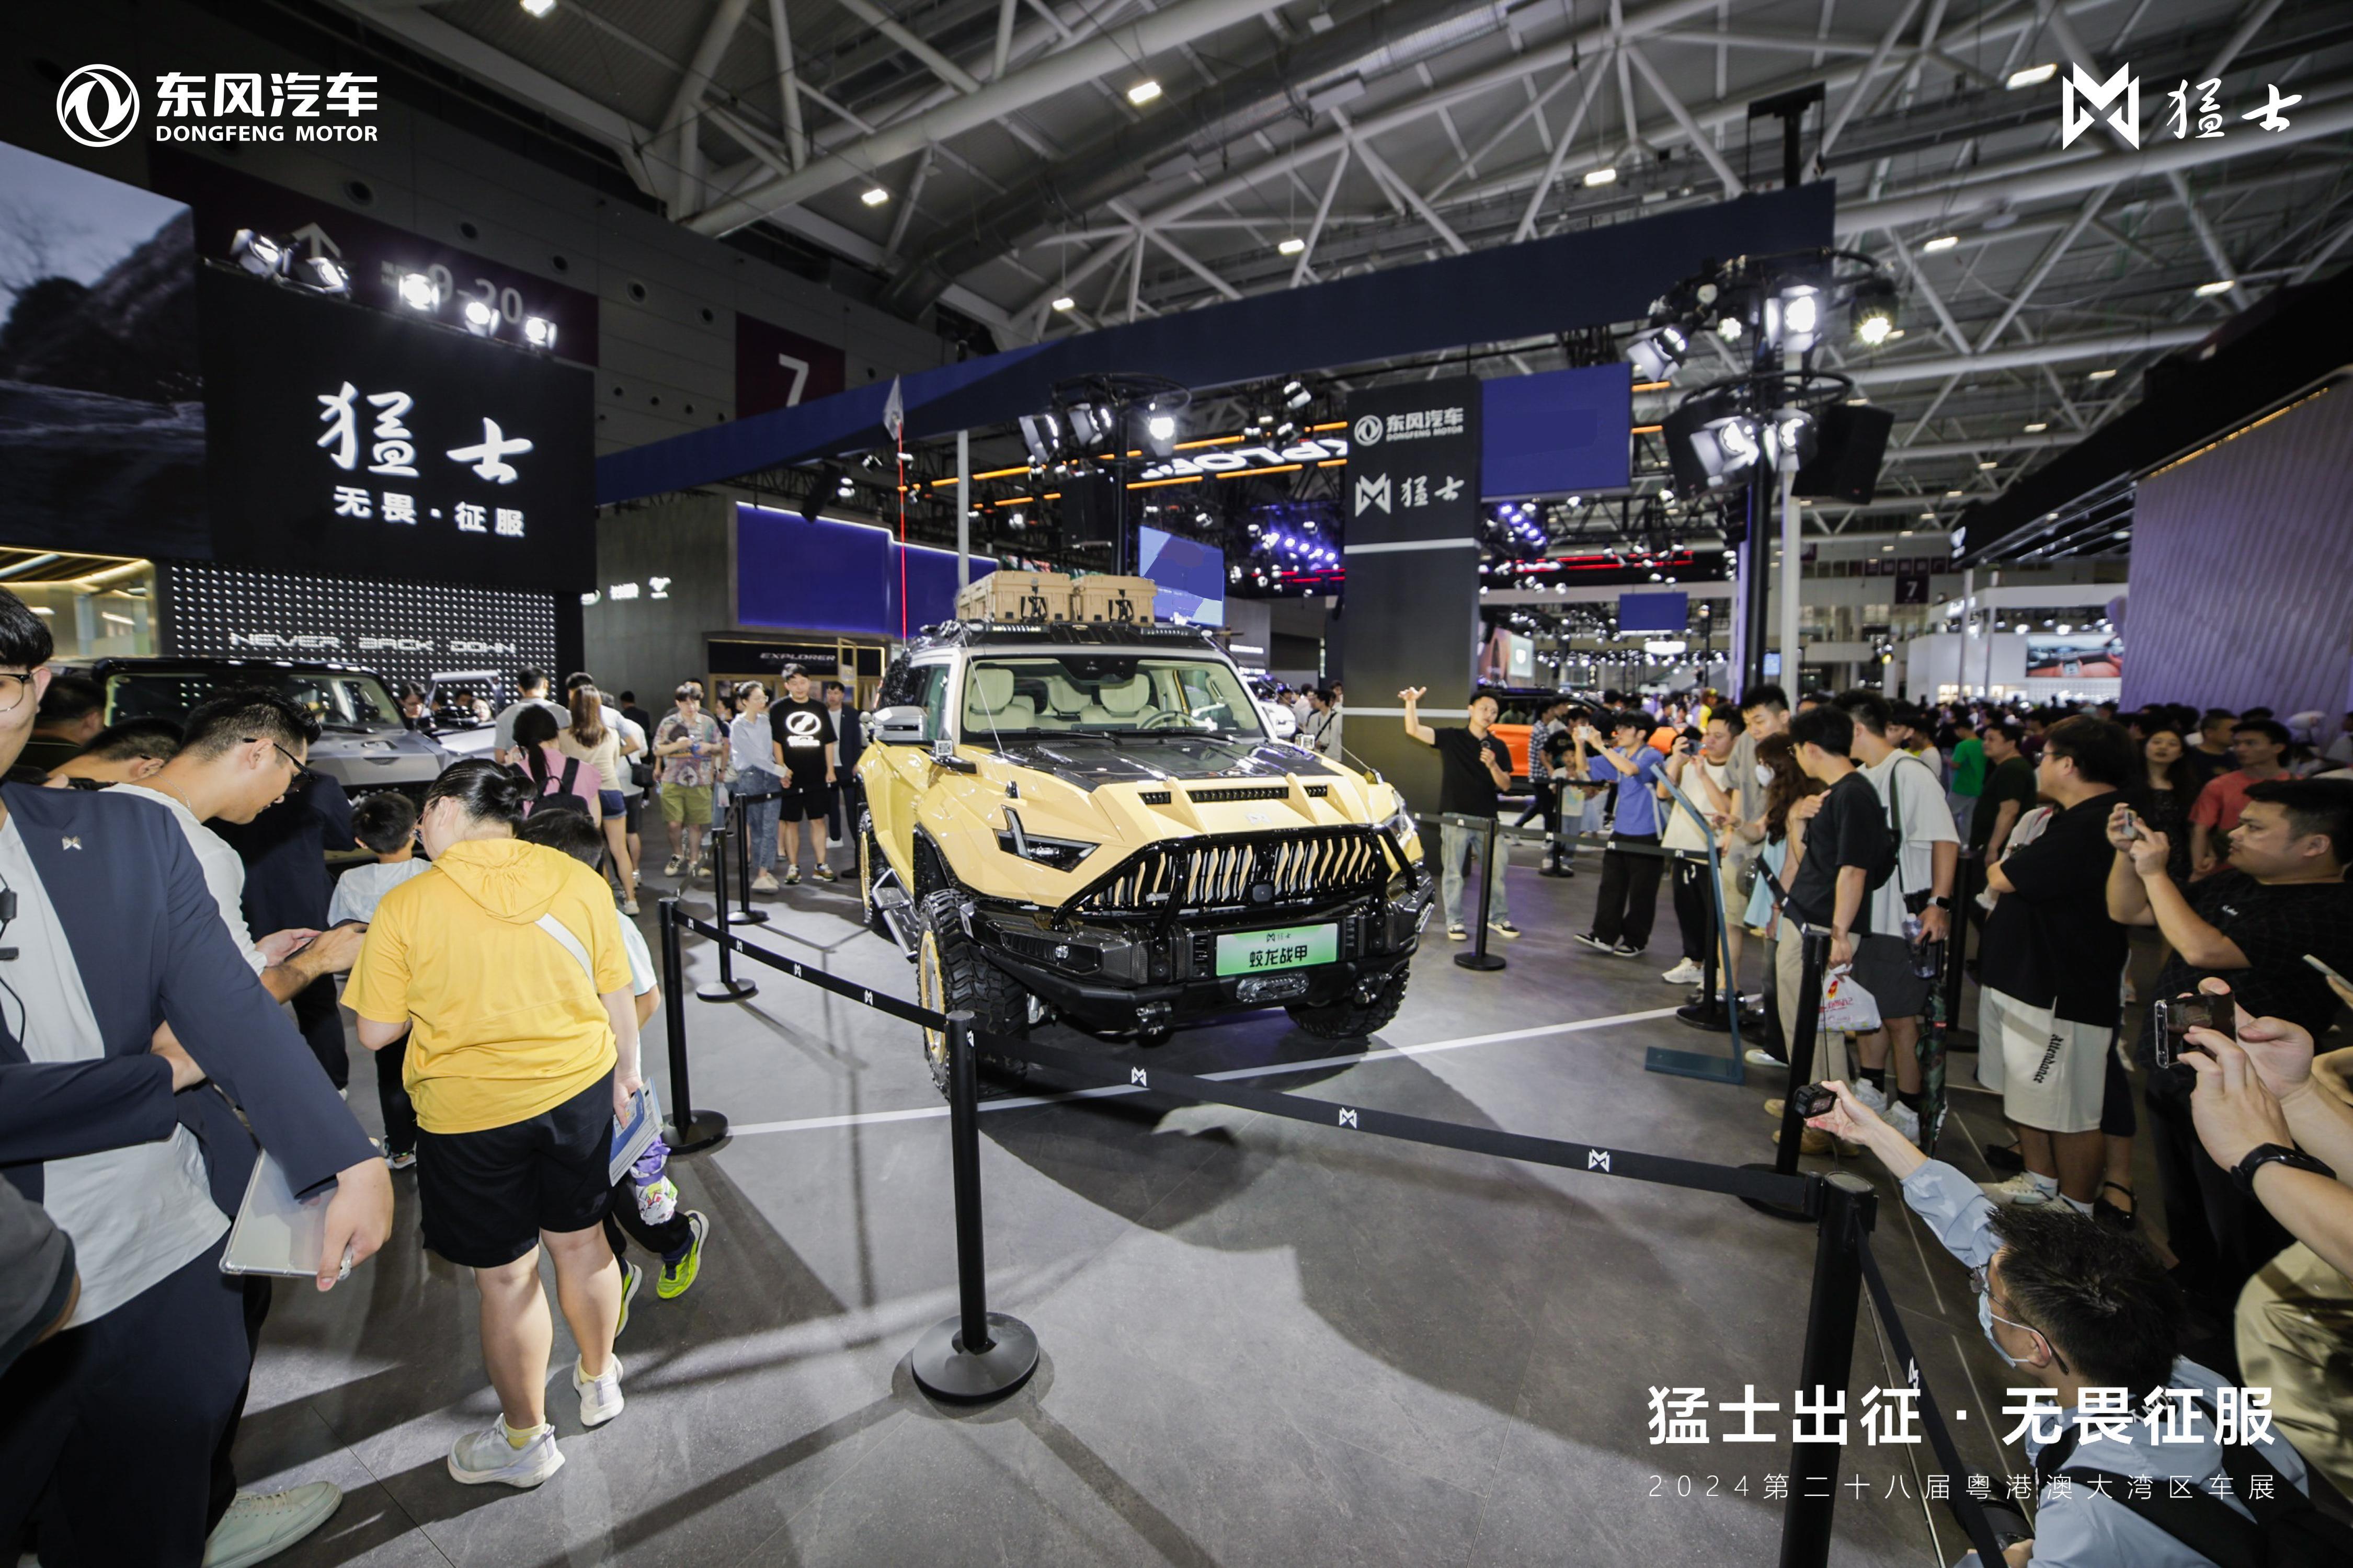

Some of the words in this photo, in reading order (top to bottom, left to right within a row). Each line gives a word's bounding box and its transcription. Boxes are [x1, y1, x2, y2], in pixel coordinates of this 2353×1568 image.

[779, 353, 809, 407] 7
[1386, 407, 1464, 430] 东风汽车
[317, 381, 533, 484] 猛士
[1386, 429, 1431, 442] DONGFENG
[1433, 424, 1464, 437] MOTOR
[1401, 475, 1465, 508] 猛士
[333, 485, 525, 537] 无畏·征服
[1906, 581, 1918, 598] 7
[231, 632, 341, 649] NEVER
[358, 637, 435, 651] BACK
[450, 640, 517, 654] DOWN
[760, 653, 836, 661] EXPLORER
[1249, 945, 1308, 967] 蛟龙战甲
